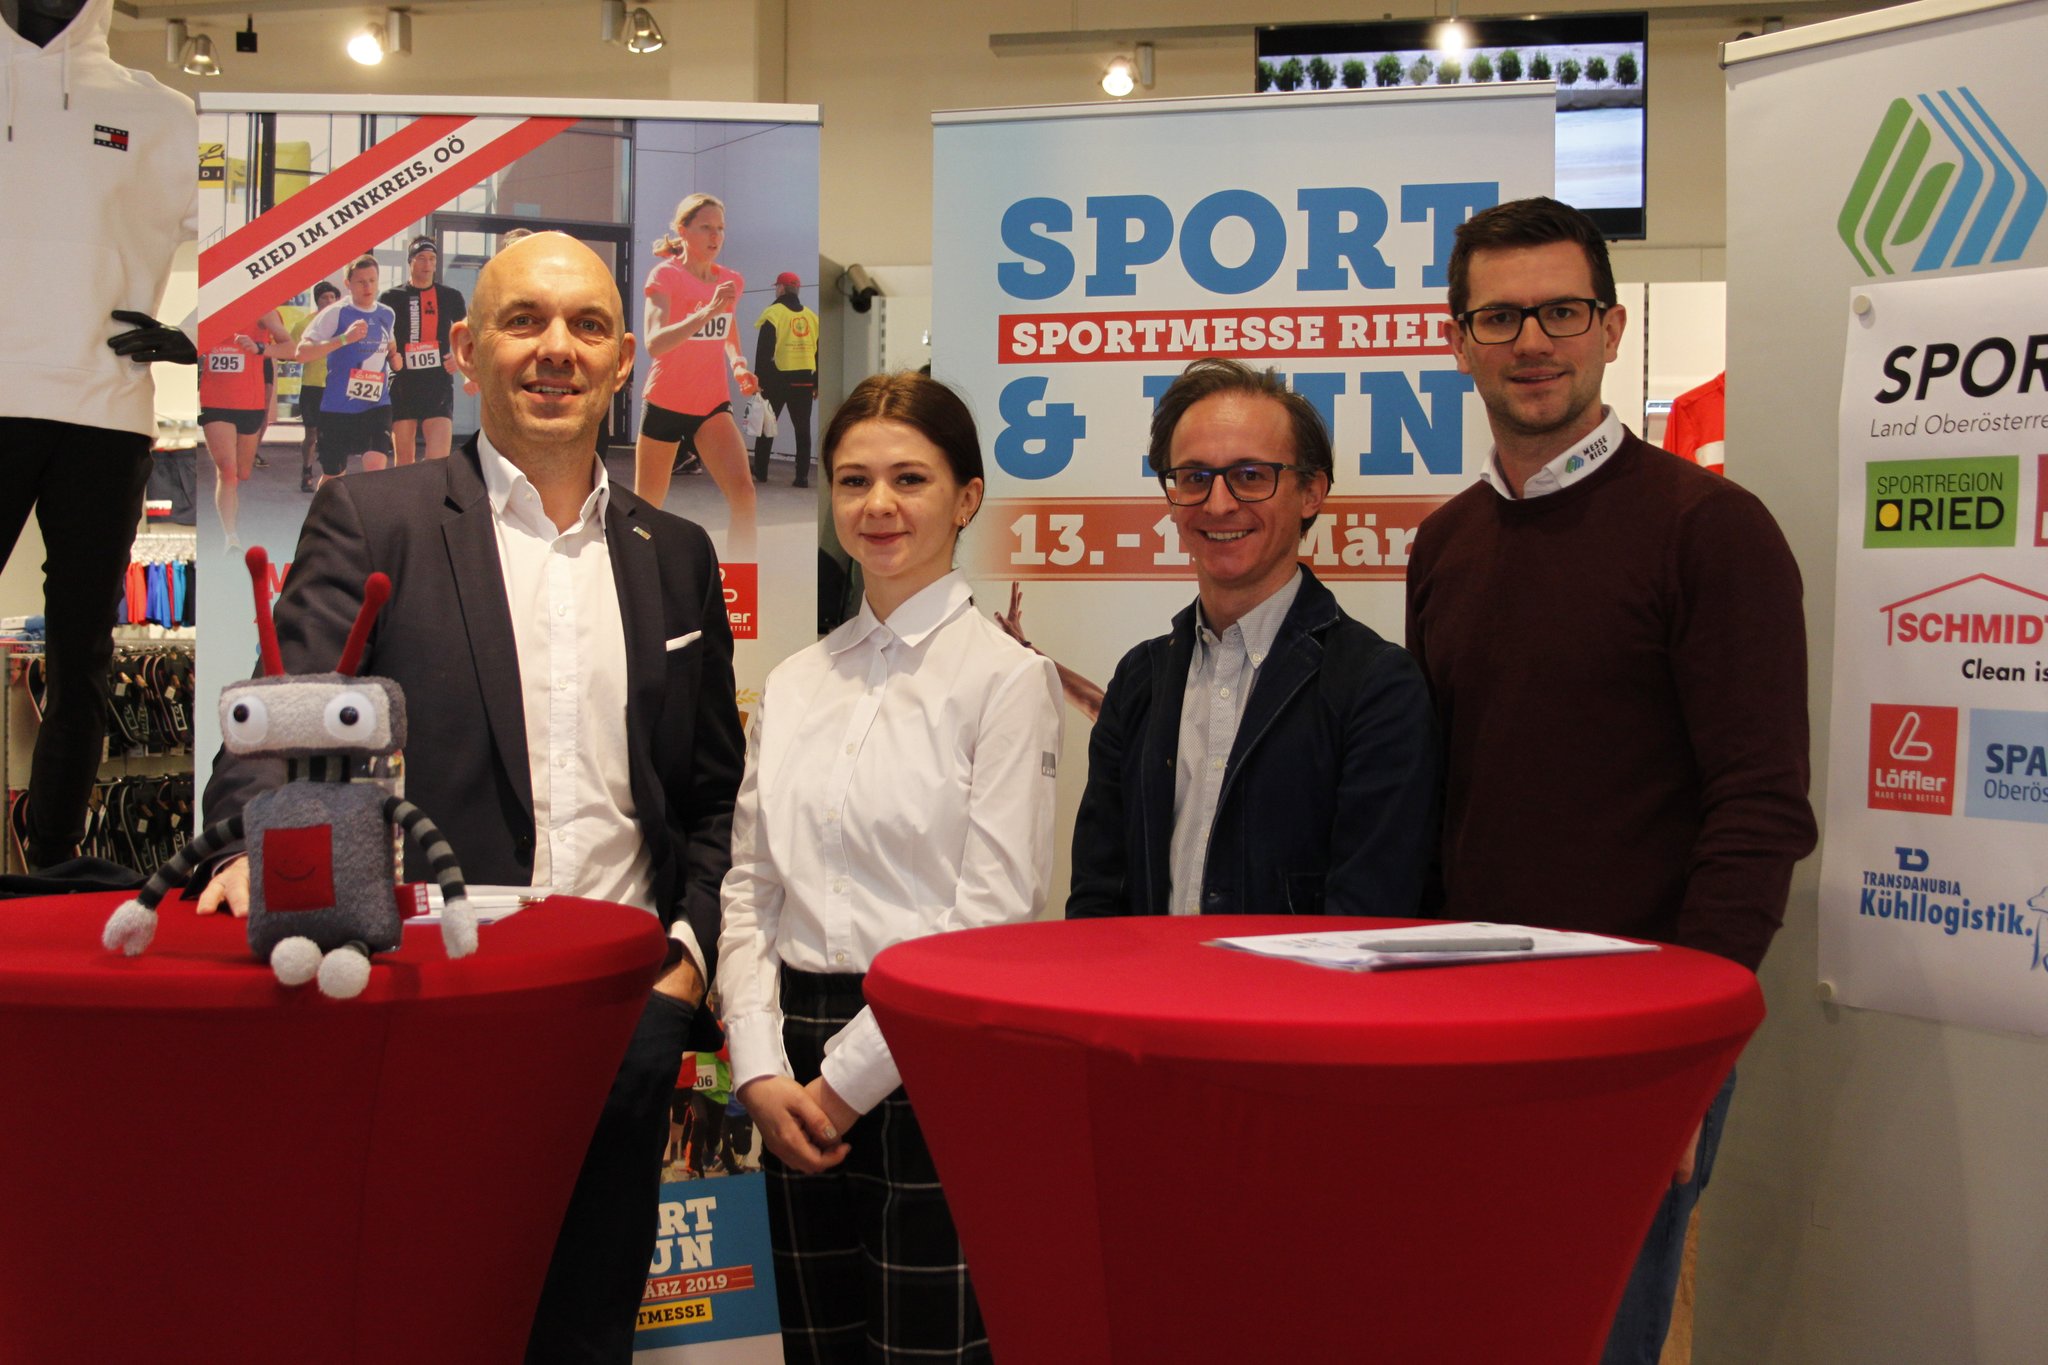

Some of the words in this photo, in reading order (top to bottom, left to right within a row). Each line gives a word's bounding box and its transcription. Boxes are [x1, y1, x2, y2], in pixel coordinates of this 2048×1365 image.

[246, 241, 297, 279] RIED
[297, 222, 328, 248] IM
[327, 160, 434, 230] INNKREIS,
[434, 135, 465, 163] OÖ
[997, 182, 1499, 300] SPORT
[1011, 315, 1324, 356] SPORTMESSE
[1338, 312, 1454, 349] RIED
[211, 356, 239, 370] 295
[410, 353, 436, 367] 105
[1874, 333, 2048, 404] SPOR
[353, 382, 381, 399] 324
[994, 375, 1086, 480] &
[1870, 415, 1918, 437] Land
[1583, 435, 1607, 456] MESSE
[1589, 445, 1608, 461] RIED
[1877, 472, 2003, 495] SPORTREGION
[1909, 496, 2004, 531] RIED
[1962, 658, 2025, 681] Clean
[1985, 743, 2048, 777] SPA
[1876, 768, 1946, 792] Löffler
[1863, 871, 1961, 896] TRANSDANUBIA
[1860, 887, 2033, 936] Kühllogistik.
[694, 1075, 713, 1088] 06
[686, 1274, 727, 1293] 2019
